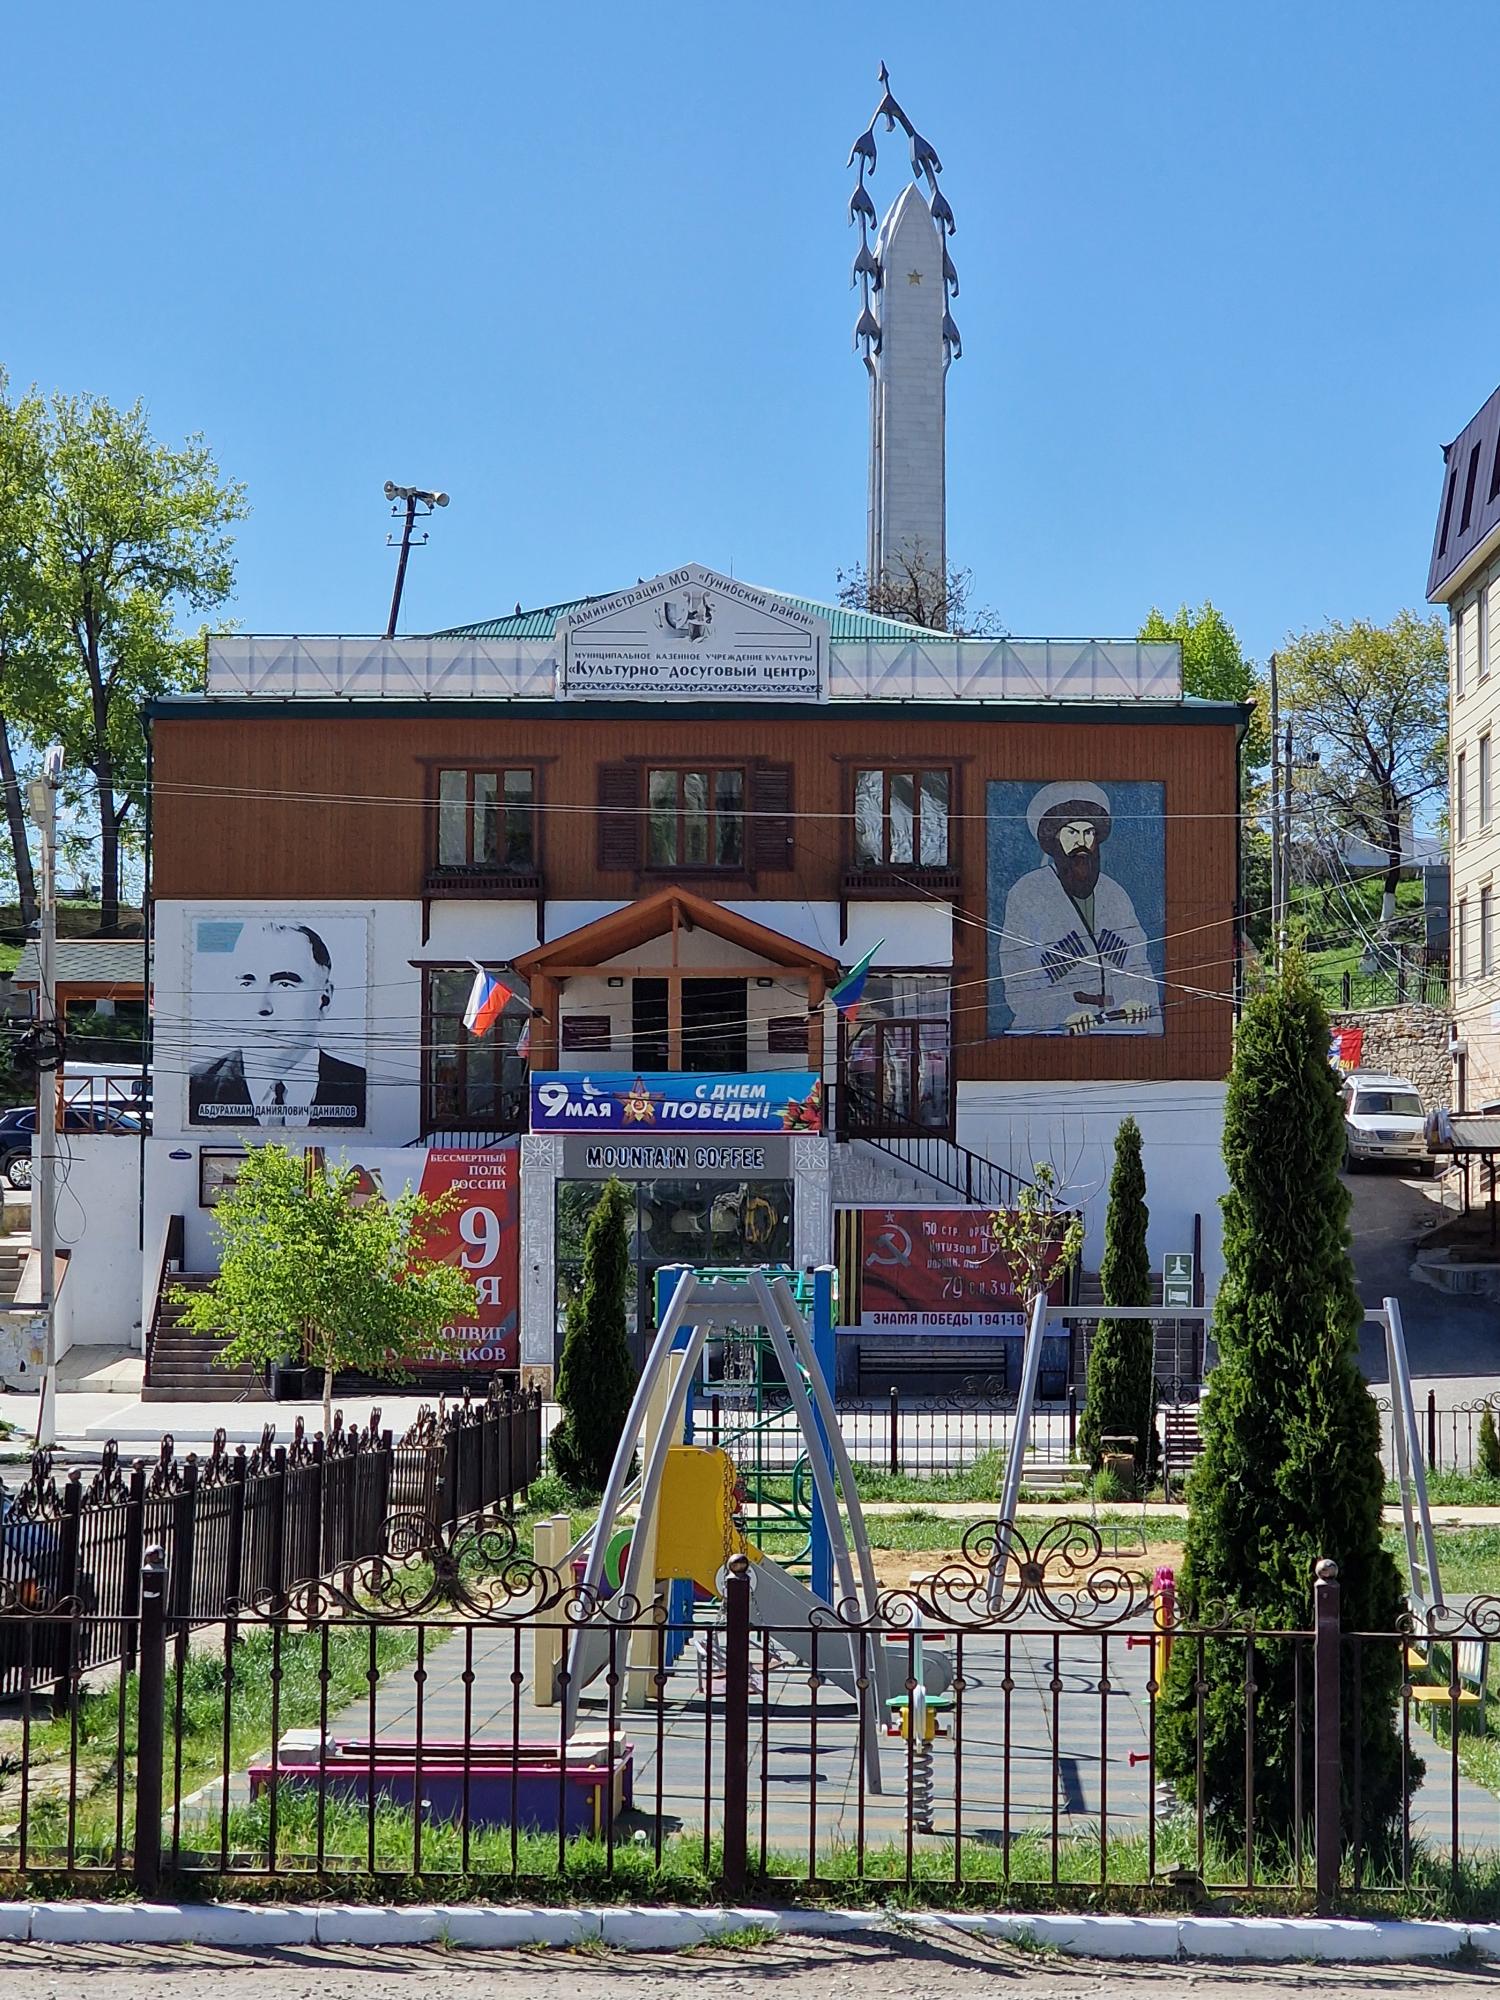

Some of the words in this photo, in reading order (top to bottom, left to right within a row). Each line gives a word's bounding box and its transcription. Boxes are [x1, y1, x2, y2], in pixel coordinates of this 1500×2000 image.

[568, 580, 665, 627] Администрация
[669, 570, 690, 588] МО
[698, 572, 767, 607] «Гунибский
[769, 602, 815, 626] район»
[574, 652, 651, 661] МУНИЦИПАЛЬНОЕ
[656, 652, 700, 661] КАЗЕННОЕ
[705, 653, 763, 663] УЧРЕЖДЕНИЕ
[765, 654, 813, 662] КУЛЬТУРЫ
[763, 667, 816, 681] центр»
[538, 1082, 569, 1117] 9
[565, 1102, 612, 1118] МАЯ
[695, 1084, 707, 1099] С
[709, 1084, 766, 1101] ДНЕМ
[199, 1103, 251, 1118] АБДУРАХМАН
[254, 1105, 310, 1117] ДАНИЯЛОВИЧ
[312, 1105, 357, 1118] ДАНИЯЛОВ
[661, 1101, 770, 1122] ПОБЕДЫ!
[430, 1153, 507, 1163] БЕССМЕРТНЫЙ
[585, 1146, 689, 1169] MOUNTAIN
[695, 1147, 765, 1169] COFFEE
[469, 1165, 507, 1176] ПОЛК
[451, 1178, 507, 1190] РОССИИ
[459, 1206, 501, 1269] 9
[942, 1276, 963, 1299] 79
[873, 1313, 917, 1326] ЗНАМЯ
[922, 1312, 973, 1328] ПОБЕДЫ
[436, 1325, 507, 1341] ОДВИГ
